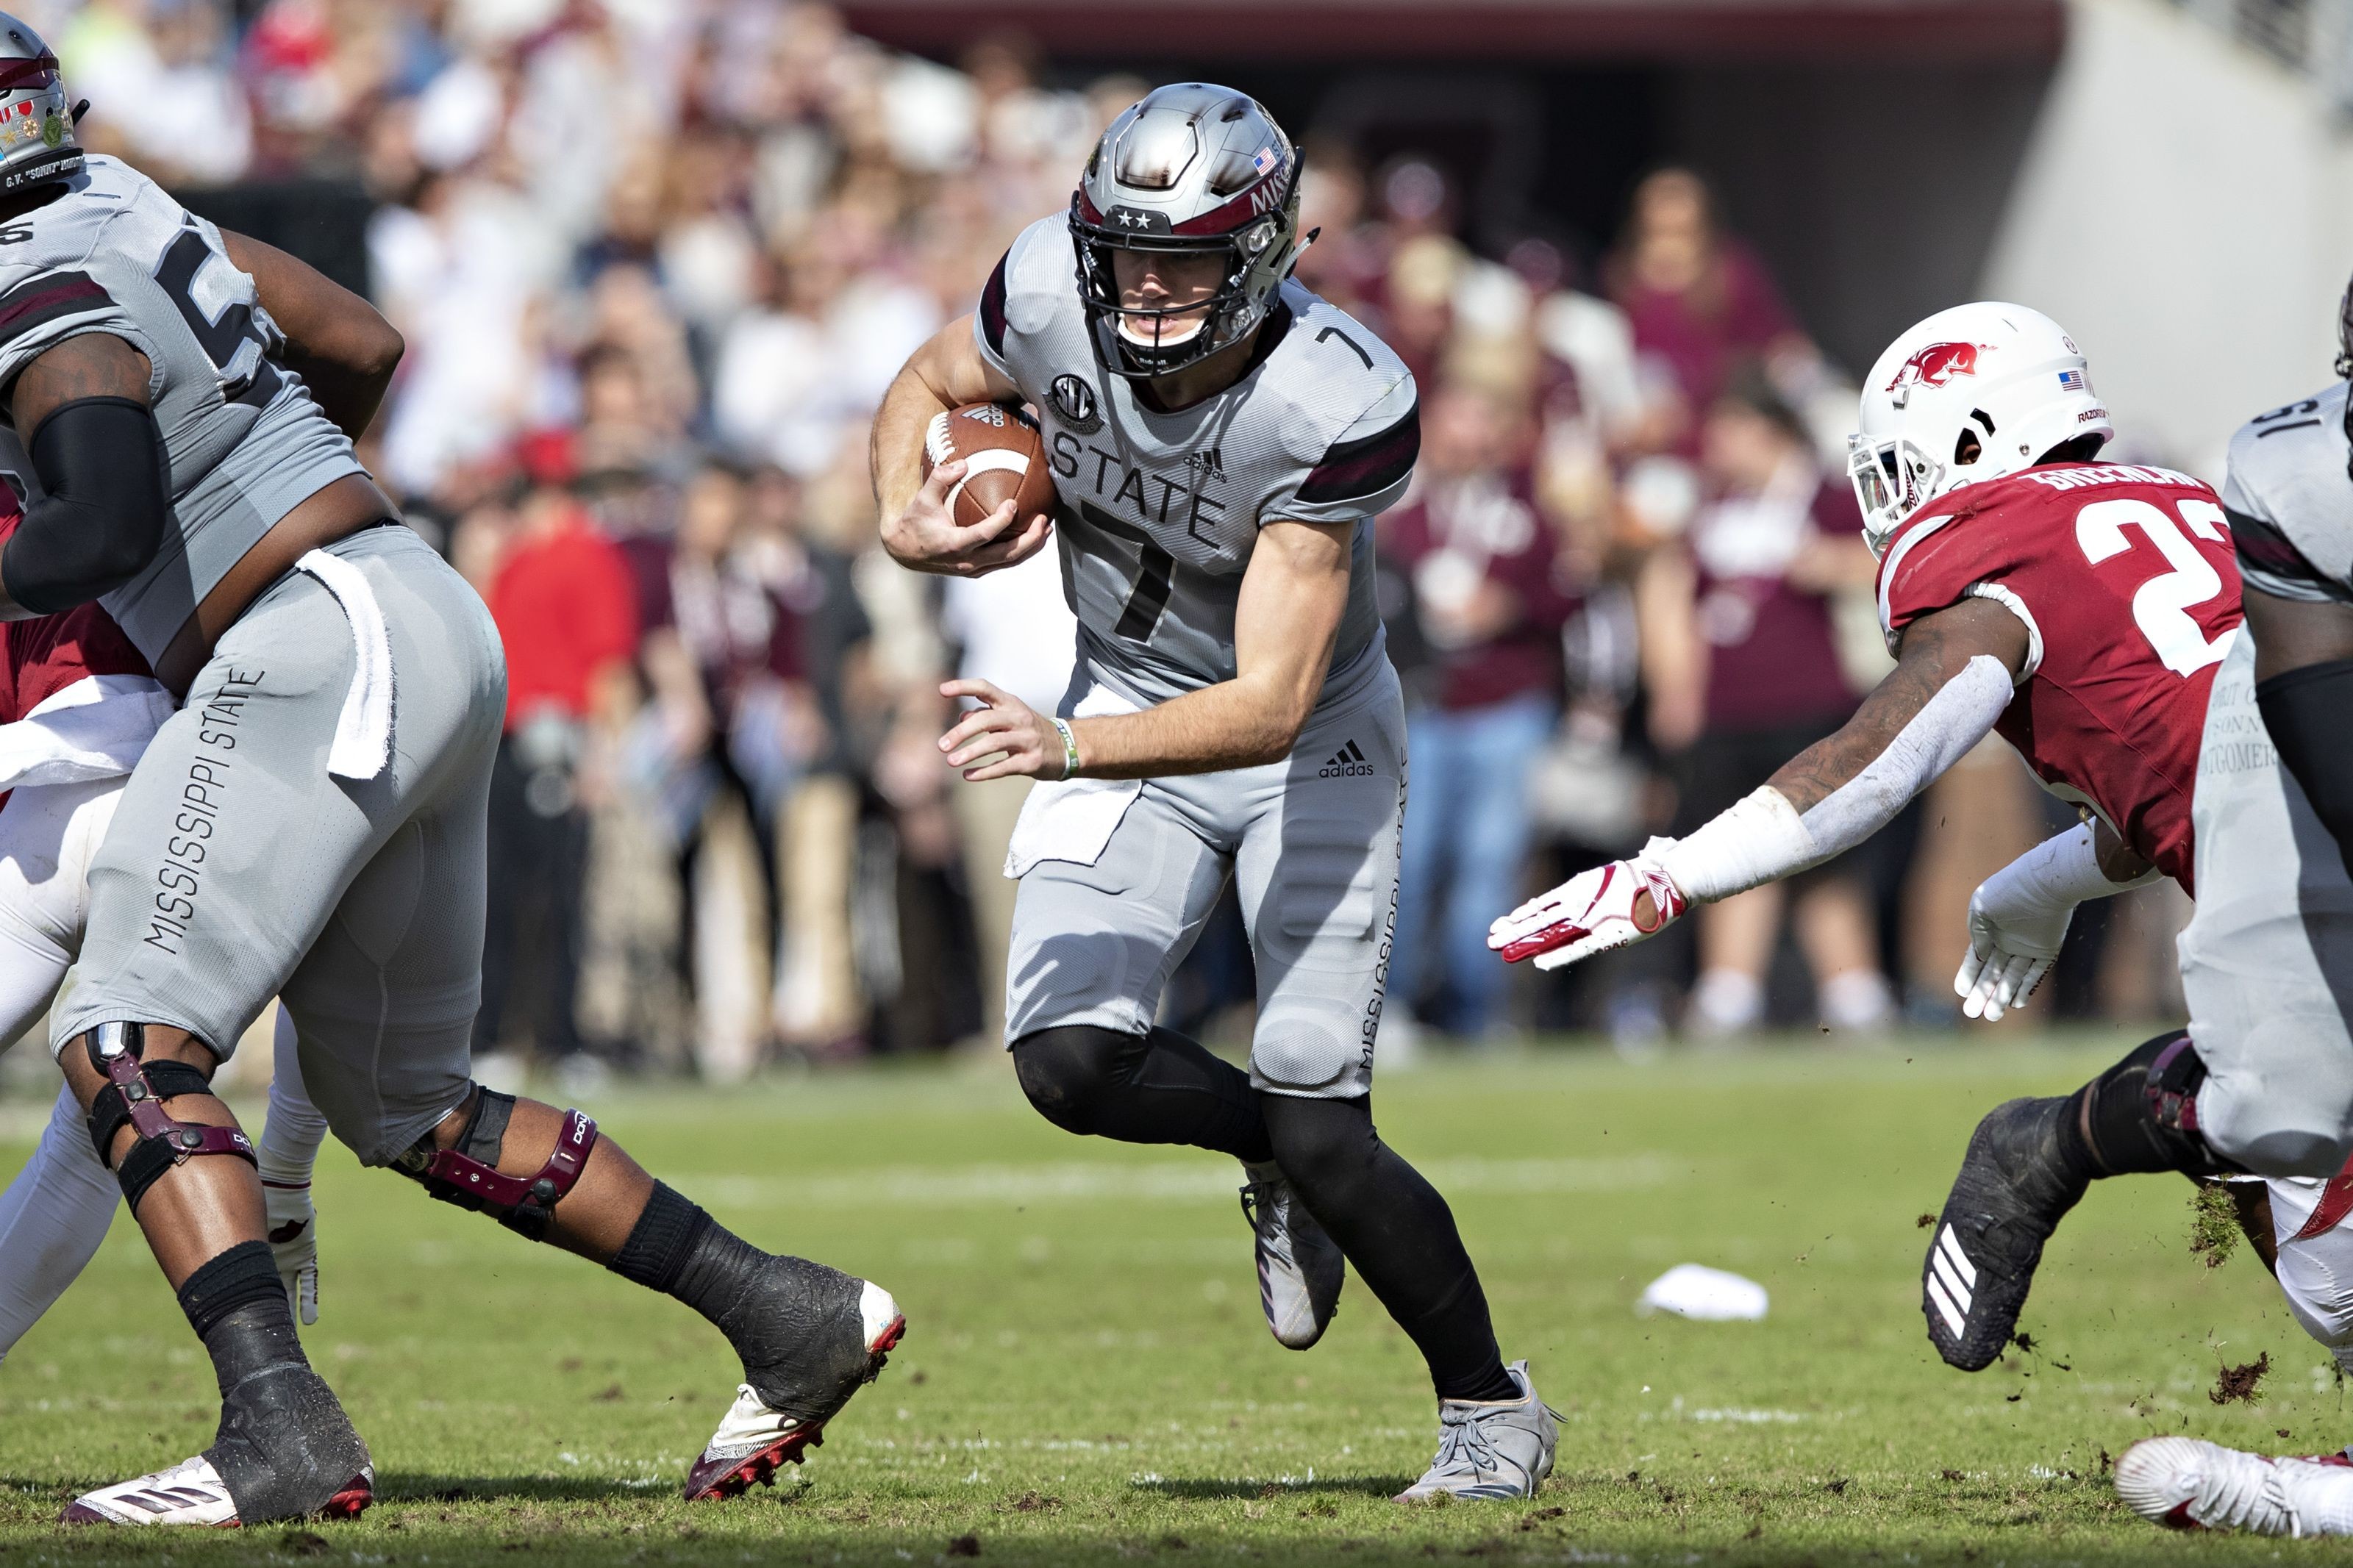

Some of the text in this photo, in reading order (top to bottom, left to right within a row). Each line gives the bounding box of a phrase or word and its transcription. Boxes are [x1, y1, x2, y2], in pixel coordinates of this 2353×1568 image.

[1314, 326, 1374, 371] 7
[1054, 376, 1092, 420] SEC
[1050, 431, 1227, 551] STATE
[1182, 455, 1228, 484] adidas
[1078, 496, 1179, 646] 7
[1318, 761, 1374, 778] adidas
[143, 667, 265, 955] MISSISSIPPI STATE
